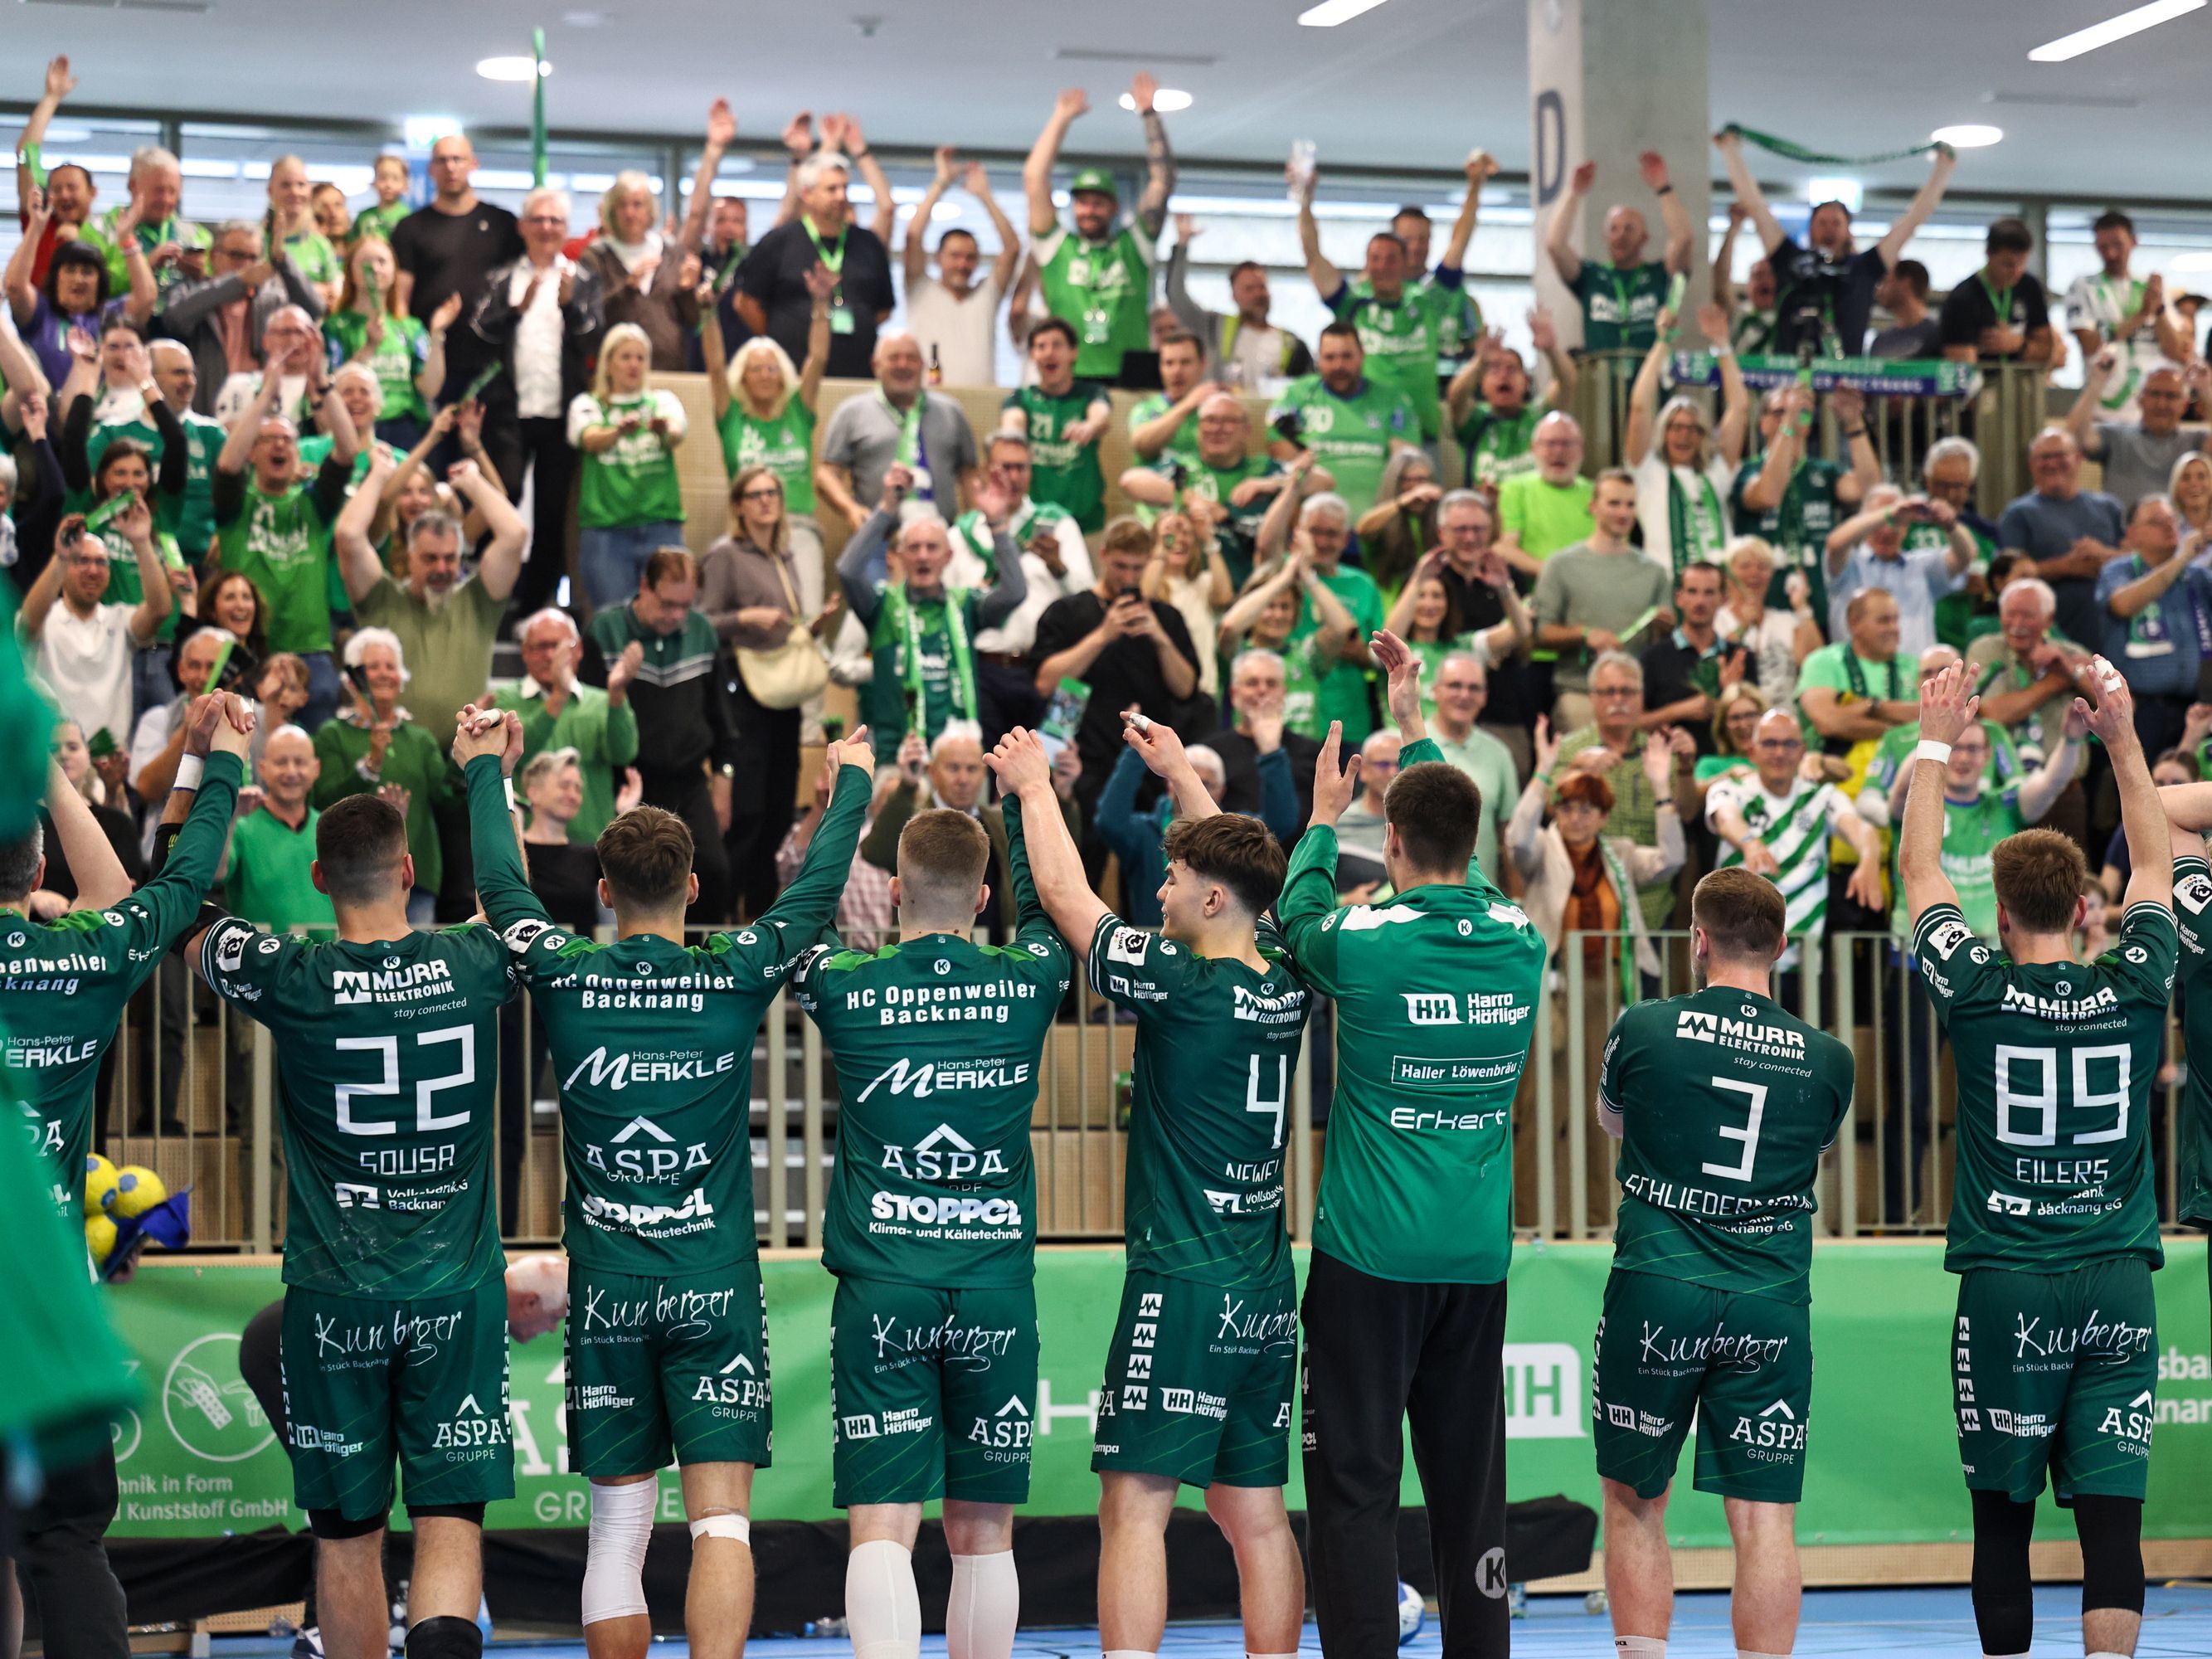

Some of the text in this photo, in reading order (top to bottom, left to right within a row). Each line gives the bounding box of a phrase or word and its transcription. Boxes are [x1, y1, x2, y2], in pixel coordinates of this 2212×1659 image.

[1538, 90, 1566, 205] D
[2180, 922, 2199, 941] Harro
[372, 959, 451, 991] MURR
[1133, 980, 1155, 990] Harro
[0, 977, 80, 995] knang
[375, 980, 455, 1003] ELEKTRONIK
[847, 989, 876, 1010] HC
[885, 980, 1036, 1007] Oppenweiler
[1133, 989, 1169, 1002] Höfliger
[394, 997, 467, 1019] stay connected
[582, 990, 703, 1013] Backnang
[1467, 993, 1514, 1009] Harro
[880, 1005, 1009, 1025] Backnang
[1468, 1005, 1530, 1025] Höfliger
[1266, 1030, 1278, 1041] stay
[1721, 1017, 1806, 1048] MURR
[2055, 1018, 2127, 1034] stay connected
[7, 1035, 75, 1047] Hans-Peter
[1719, 1035, 1806, 1061] ELEKTRONIK
[0, 1039, 98, 1068] ERKLE
[633, 1049, 703, 1060] Hans-Peter
[563, 1046, 735, 1092] MERKLE
[937, 1058, 1006, 1070] Hans-Peter
[1401, 1061, 1517, 1078] Haller Löwenbräu
[1733, 1056, 1812, 1078] stay connected
[334, 1024, 475, 1136] 22
[857, 1058, 1029, 1103] MERKLE
[1246, 1053, 1287, 1149] 4
[1995, 1043, 2132, 1146] 89
[1391, 1107, 1507, 1130] Erkert
[1701, 1076, 1768, 1182] 3
[360, 1144, 455, 1175] SOUSA
[586, 1142, 712, 1177] ASPA
[881, 1145, 1009, 1180] ASPA
[2016, 1157, 2109, 1184] EILERS
[2104, 1198, 2122, 1210] eG
[868, 1222, 1023, 1240] Klima- und Kältetechnik
[1777, 1220, 1793, 1232] eG
[581, 1335, 591, 1345] Ein
[594, 1334, 615, 1344] Stück
[1209, 1345, 1222, 1354] Ein
[1639, 1320, 1788, 1374] Kunberger
[328, 1360, 350, 1371] Stück
[874, 1363, 887, 1374] Ein
[1638, 1367, 1650, 1375] Ein
[1651, 1366, 1670, 1376] Stück
[2013, 1362, 2074, 1373] Ein Stück Back
[582, 1385, 617, 1397] Harro
[692, 1375, 765, 1408] ASPA
[1196, 1390, 1227, 1407] Harro
[582, 1395, 634, 1410] Höfliger
[712, 1406, 757, 1423] GRUPPE
[882, 1408, 919, 1423] Harro
[1640, 1410, 1665, 1427] Harro
[2014, 1412, 2046, 1425] Harro
[432, 1419, 506, 1448] ASPA
[883, 1415, 933, 1436] Höfliger
[968, 1416, 1033, 1448] ASP
[1729, 1416, 1805, 1450] ASPA
[2098, 1407, 2153, 1447] ASP
[446, 1449, 496, 1462] GRUPPE
[1747, 1448, 1795, 1465] GRUPPE
[117, 1473, 233, 1495] hnik in Form
[127, 1499, 225, 1521] Kunststoff
[230, 1499, 289, 1519] GmbH
